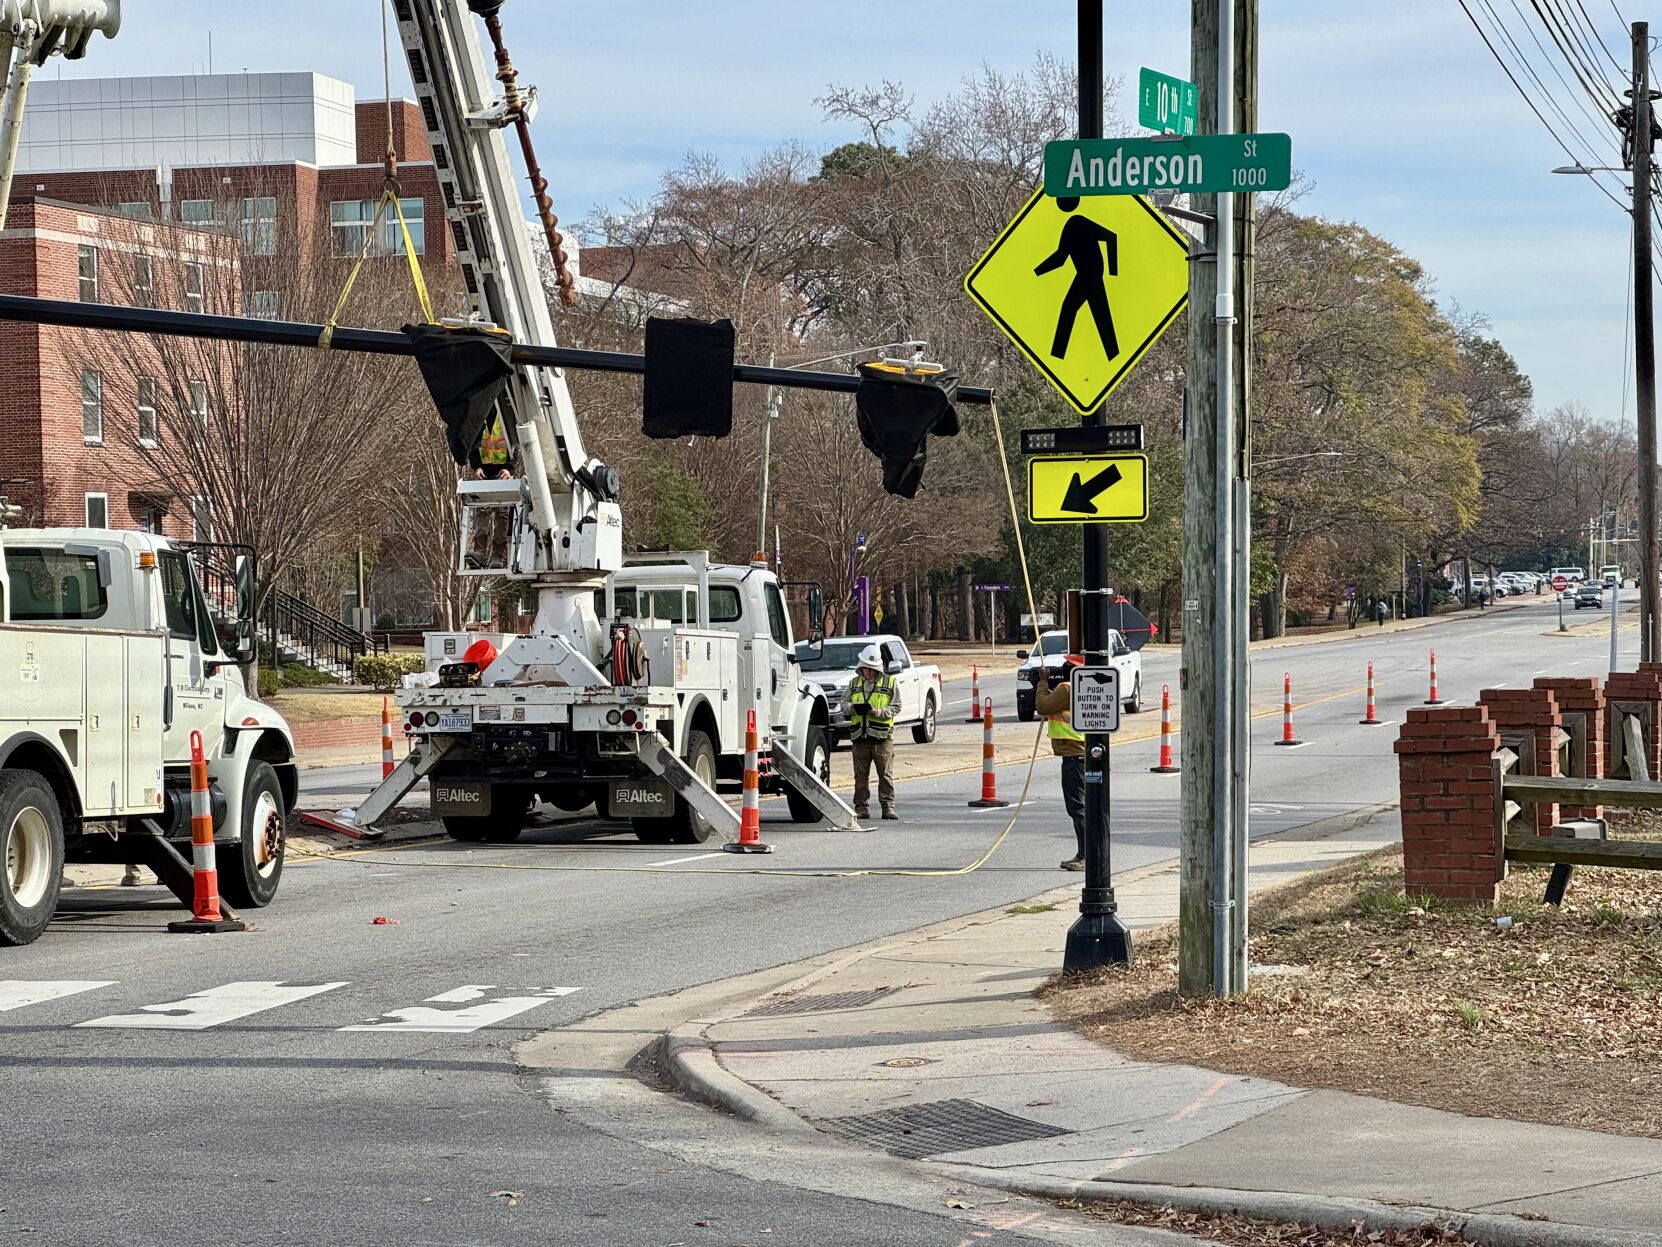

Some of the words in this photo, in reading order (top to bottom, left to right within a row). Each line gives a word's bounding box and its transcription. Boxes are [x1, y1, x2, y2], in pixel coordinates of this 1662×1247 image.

[1145, 88, 1149, 106] E
[1157, 81, 1178, 124] 10th
[1187, 89, 1193, 107] St
[1244, 139, 1258, 157] St
[1066, 146, 1203, 188] Anderson
[1231, 167, 1267, 186] 1000
[450, 788, 480, 802] Altec
[630, 789, 664, 803] Altec
